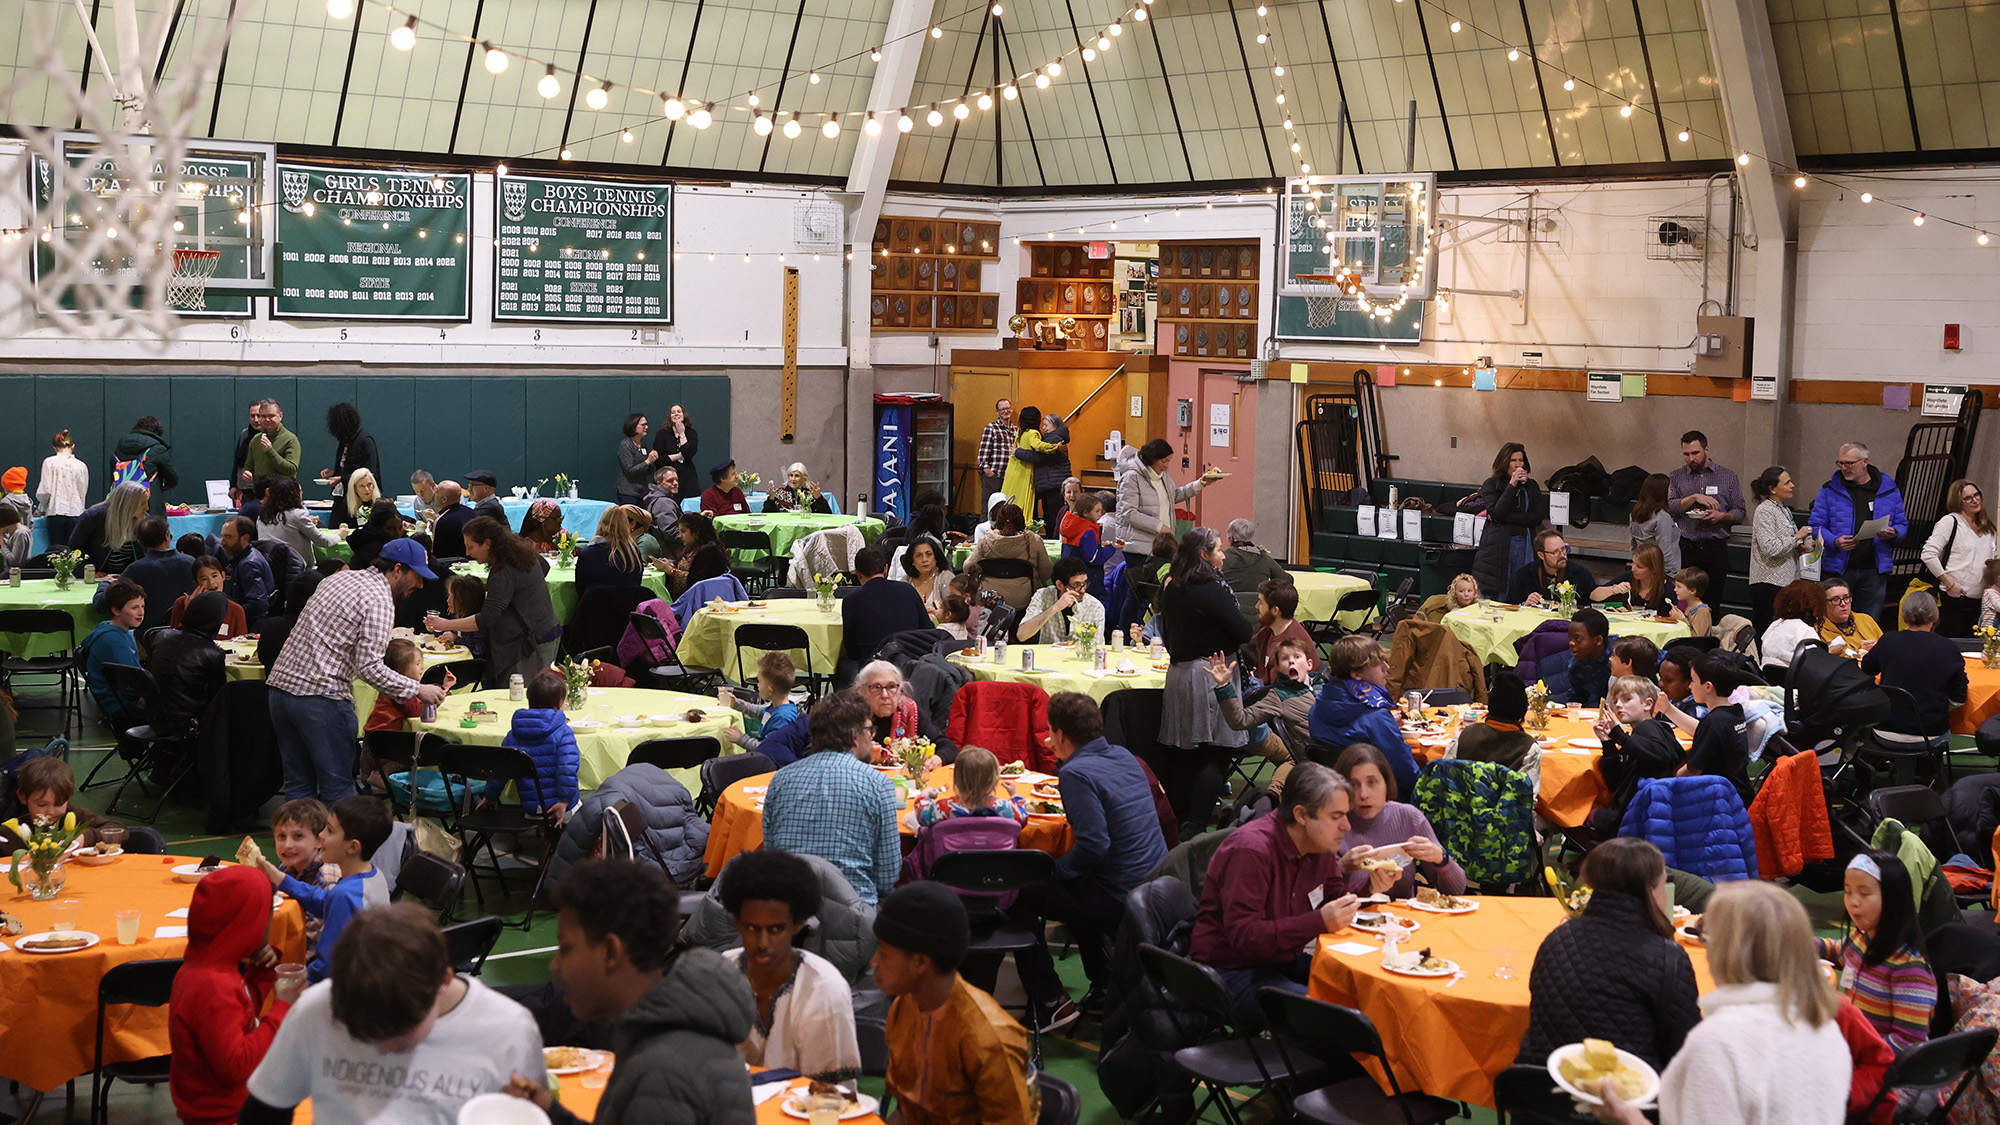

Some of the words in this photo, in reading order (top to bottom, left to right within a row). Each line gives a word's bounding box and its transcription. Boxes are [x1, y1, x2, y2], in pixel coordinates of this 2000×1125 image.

[150, 162, 230, 179] AROSSE
[325, 175, 380, 191] GIRLS
[313, 189, 464, 209] CHAMPIONSHIPS
[544, 185, 588, 200] BOYS
[593, 188, 656, 204] TENNIS
[530, 199, 665, 217] CHAMPIONSHIPS
[338, 209, 410, 221] CONFERENCE
[553, 216, 617, 229] CONFERENCE
[502, 226, 521, 234] 2009
[523, 226, 538, 234] 2010
[540, 228, 557, 236] 2015
[586, 230, 603, 238] 2017
[606, 231, 622, 239] 2018
[625, 231, 642, 239] 2019
[647, 232, 662, 240] 2021
[502, 237, 521, 245] 2022
[347, 242, 401, 254] REGIONAL
[502, 249, 519, 257] 2021
[304, 254, 325, 262] 2002
[329, 254, 349, 263] 2006
[352, 256, 369, 264] 2011
[372, 256, 390, 265] 2012
[394, 257, 411, 266] 2013
[414, 258, 433, 266] 2014
[436, 258, 455, 266] 2022
[560, 249, 608, 260] RGIONA
[501, 259, 520, 267] 2000
[523, 259, 541, 268] 2002
[545, 260, 562, 269] 2005
[565, 261, 582, 270] 2006
[585, 262, 603, 271] 2008
[606, 263, 624, 271] 2009
[627, 264, 642, 272] 2010
[645, 264, 659, 272] 2011
[501, 269, 518, 277] 2012
[523, 269, 539, 277] 2013
[545, 270, 561, 278] 2014
[565, 271, 581, 279] 2015
[586, 271, 602, 280] 2016
[606, 272, 623, 280] 2017
[626, 272, 642, 281] 2018
[644, 273, 661, 281] 2019
[359, 277, 390, 288] STATE
[501, 282, 518, 291] 2021
[544, 284, 562, 293] 2022
[570, 282, 598, 293] STATE
[305, 289, 325, 298] 2002
[328, 290, 349, 299] 2006
[352, 291, 369, 300] 2011
[373, 292, 391, 300] 2012
[395, 292, 414, 300] 2013
[417, 292, 434, 301] 2014
[606, 285, 624, 293] 2023
[501, 292, 519, 301] 2000
[522, 293, 541, 302] 2004
[544, 294, 562, 302] 2005
[565, 295, 582, 303] 2006
[586, 296, 604, 304] 2008
[606, 296, 622, 305] 2009
[625, 297, 642, 305] 2010
[645, 297, 659, 305] 2011
[501, 303, 518, 311] 2012
[521, 303, 539, 311] 2013
[545, 304, 561, 312] 2014
[565, 304, 581, 312] 2015
[586, 305, 602, 313] 2016
[606, 305, 622, 313] 2017
[625, 306, 642, 314] 2018
[644, 306, 661, 314] 2019
[230, 325, 239, 339] 6
[340, 328, 348, 341] 5
[439, 328, 446, 340] 4
[534, 329, 541, 340] 3
[631, 329, 638, 340] 2
[744, 330, 749, 341] 1
[878, 425, 902, 516] ASANI
[323, 1057, 428, 1090] INDIGENOUS
[433, 1073, 482, 1099] ALLY
